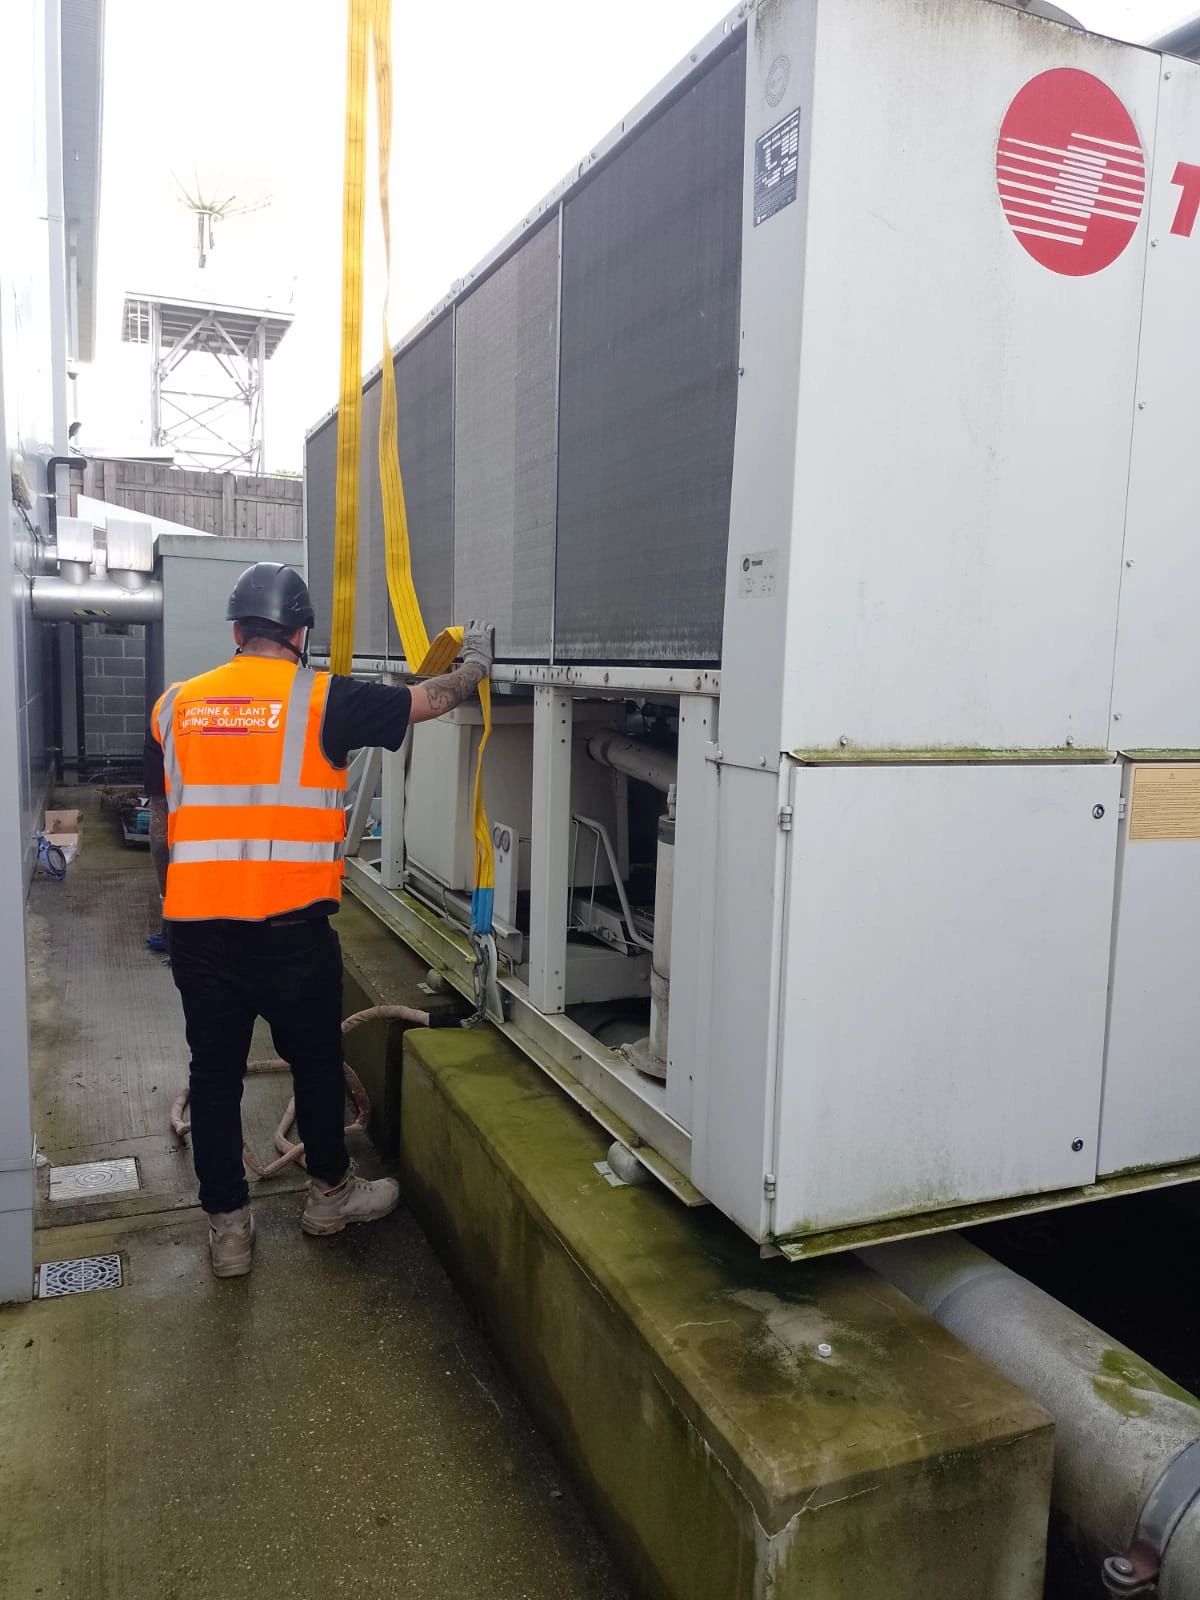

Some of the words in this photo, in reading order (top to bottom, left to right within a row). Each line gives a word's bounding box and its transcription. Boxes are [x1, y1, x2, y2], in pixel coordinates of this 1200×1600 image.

[177, 707, 221, 717] MACHINE
[223, 708, 230, 716] &
[232, 705, 267, 715] PLANT
[211, 716, 266, 727] SOLUTIONS
